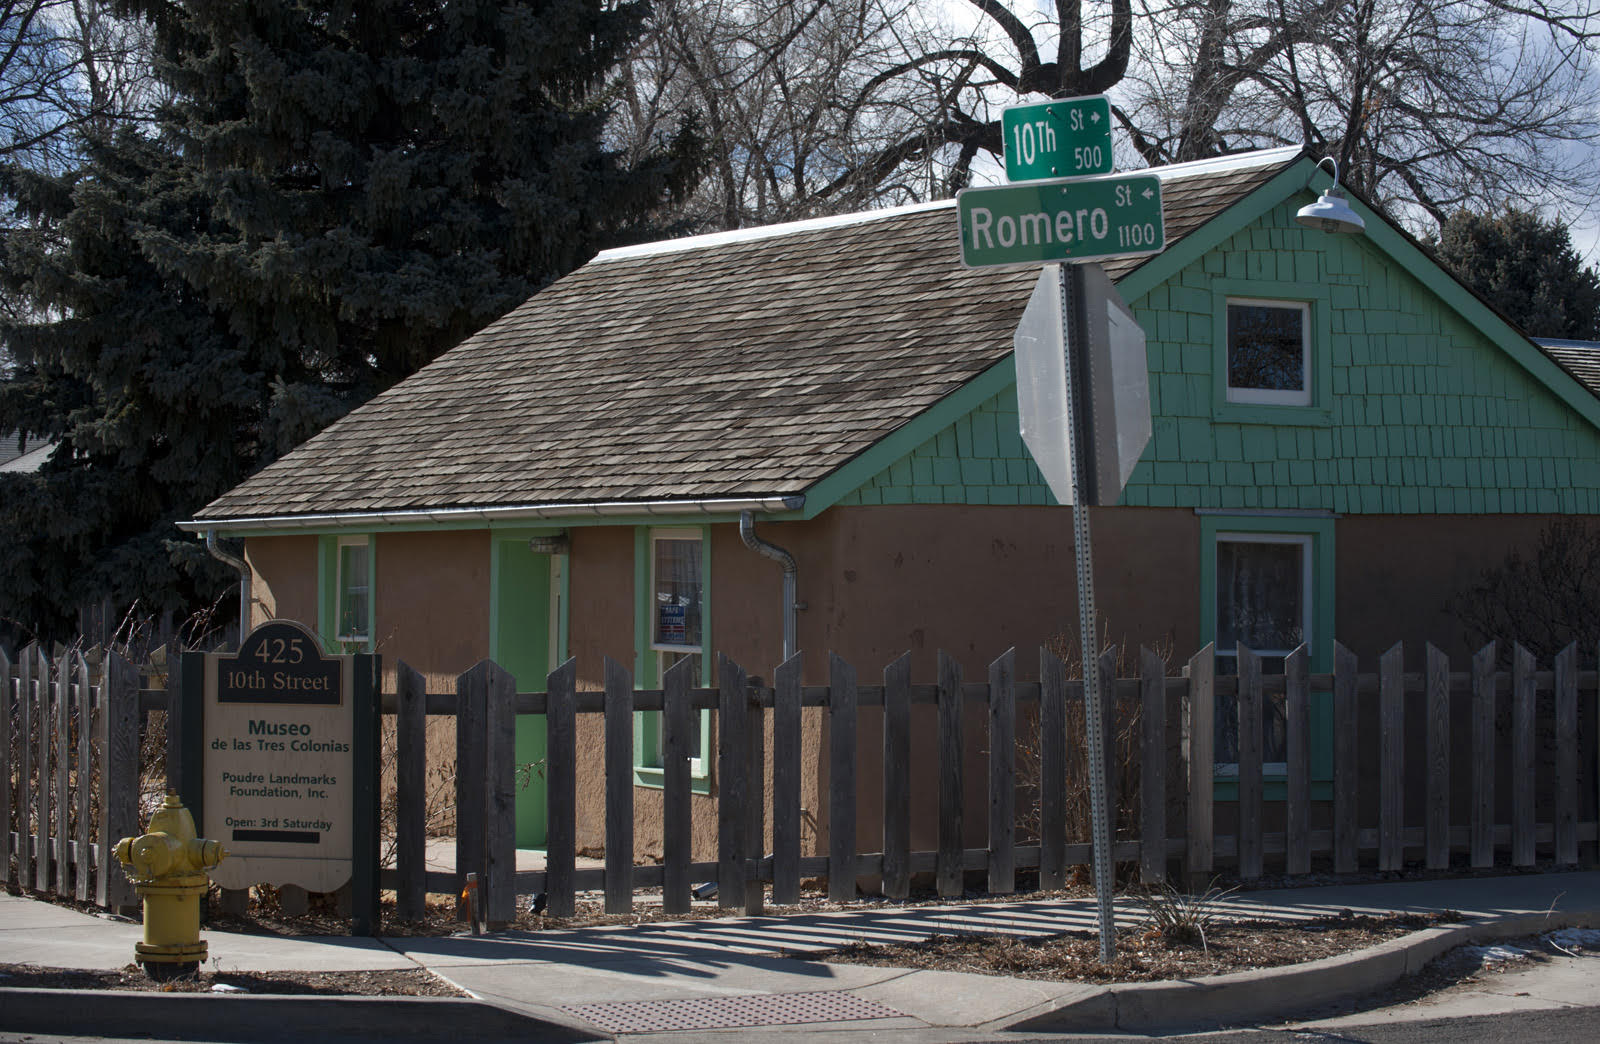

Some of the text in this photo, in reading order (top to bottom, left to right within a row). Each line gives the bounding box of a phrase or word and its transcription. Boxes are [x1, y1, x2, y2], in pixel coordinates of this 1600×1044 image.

[1070, 108, 1085, 131] St
[1075, 145, 1102, 170] 500
[1115, 185, 1133, 207] St
[970, 207, 1108, 250] Romero
[1118, 223, 1155, 247] 1100
[254, 638, 304, 664] 425
[228, 670, 329, 690] 10th Street
[248, 719, 311, 736] Museo
[211, 738, 350, 752] de las Tres Colonias
[222, 772, 337, 785] Poudre Landmarks
[229, 786, 329, 799] Foundation, Inc.
[225, 817, 333, 832] Open: 3rd Saturday
